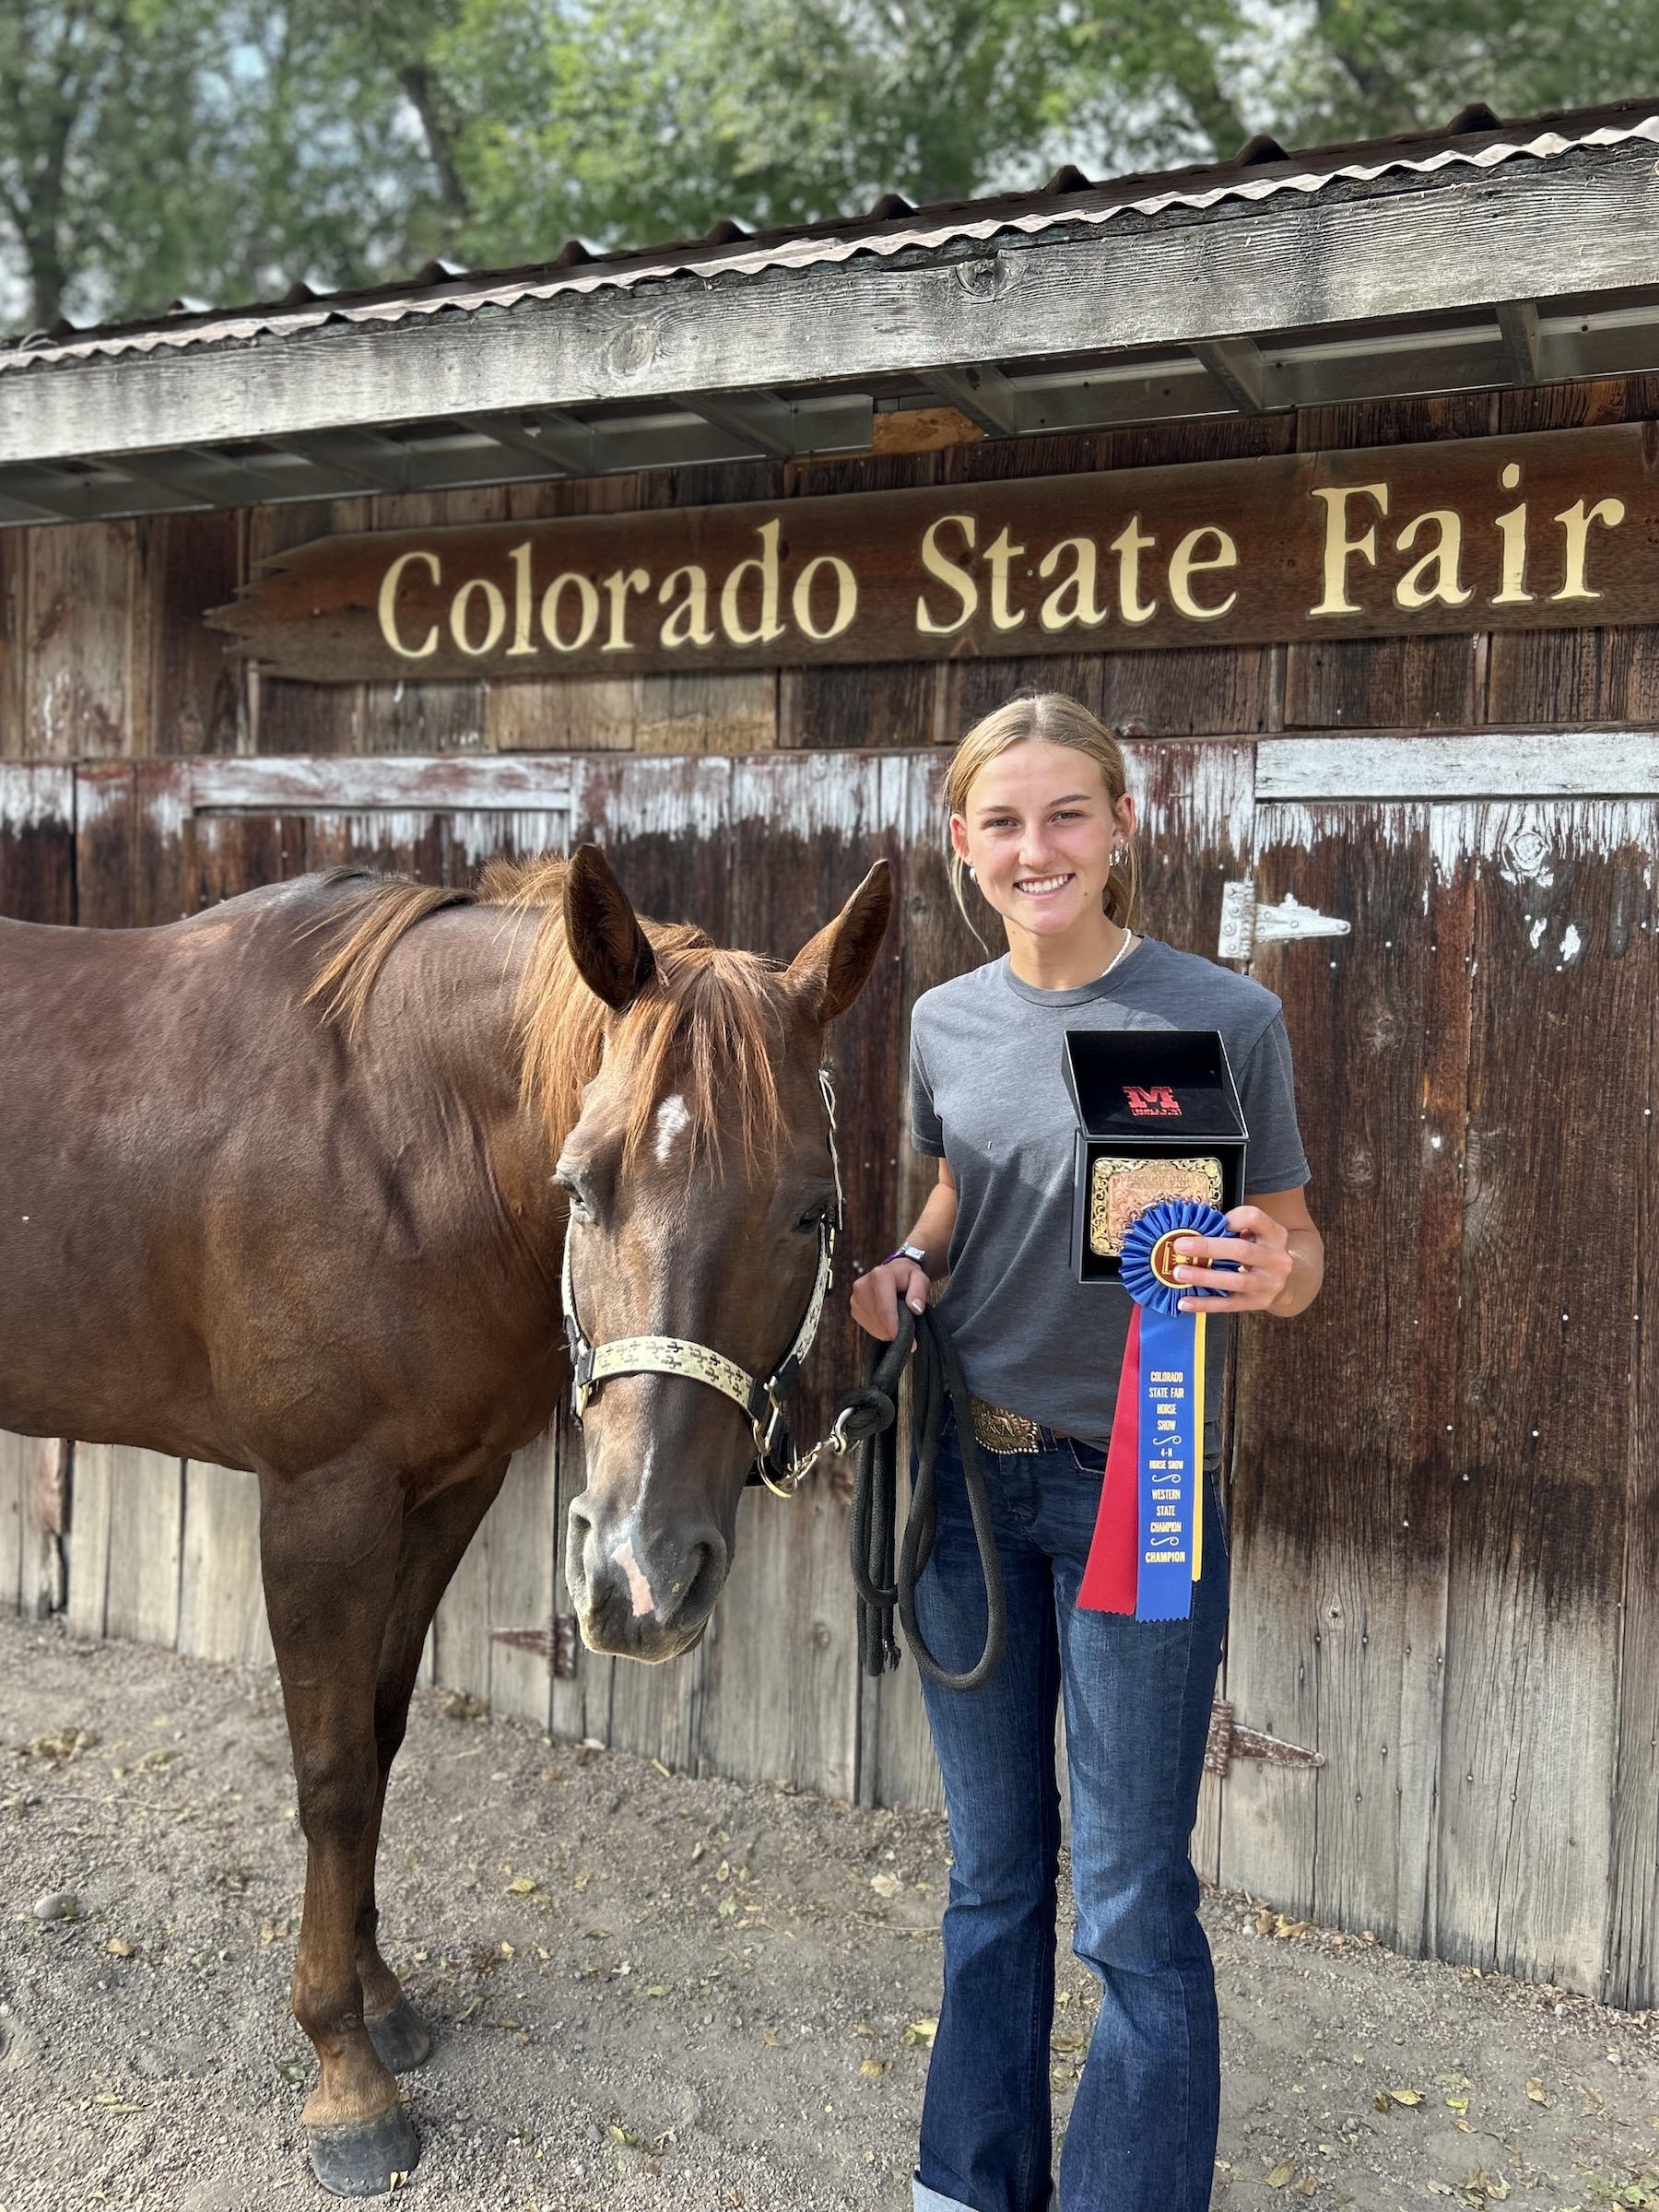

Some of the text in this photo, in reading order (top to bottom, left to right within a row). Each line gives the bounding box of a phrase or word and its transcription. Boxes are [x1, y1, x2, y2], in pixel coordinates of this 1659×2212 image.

[378, 462, 1626, 659] Colorado State Fair
[1122, 1086, 1180, 1109] M
[1149, 1371, 1184, 1383] COLORADO
[1147, 1386, 1185, 1399] STATE FAIR
[1156, 1403, 1178, 1416] HORSE
[1156, 1419, 1177, 1431] SHOW
[1159, 1447, 1173, 1458] 4-H
[1148, 1459, 1184, 1470] HORSE SHOW
[1151, 1488, 1182, 1500] WESTERN
[1156, 1504, 1176, 1517] STATE
[1149, 1521, 1182, 1534] CHAMPION
[1145, 1550, 1186, 1564] CHAMPION
